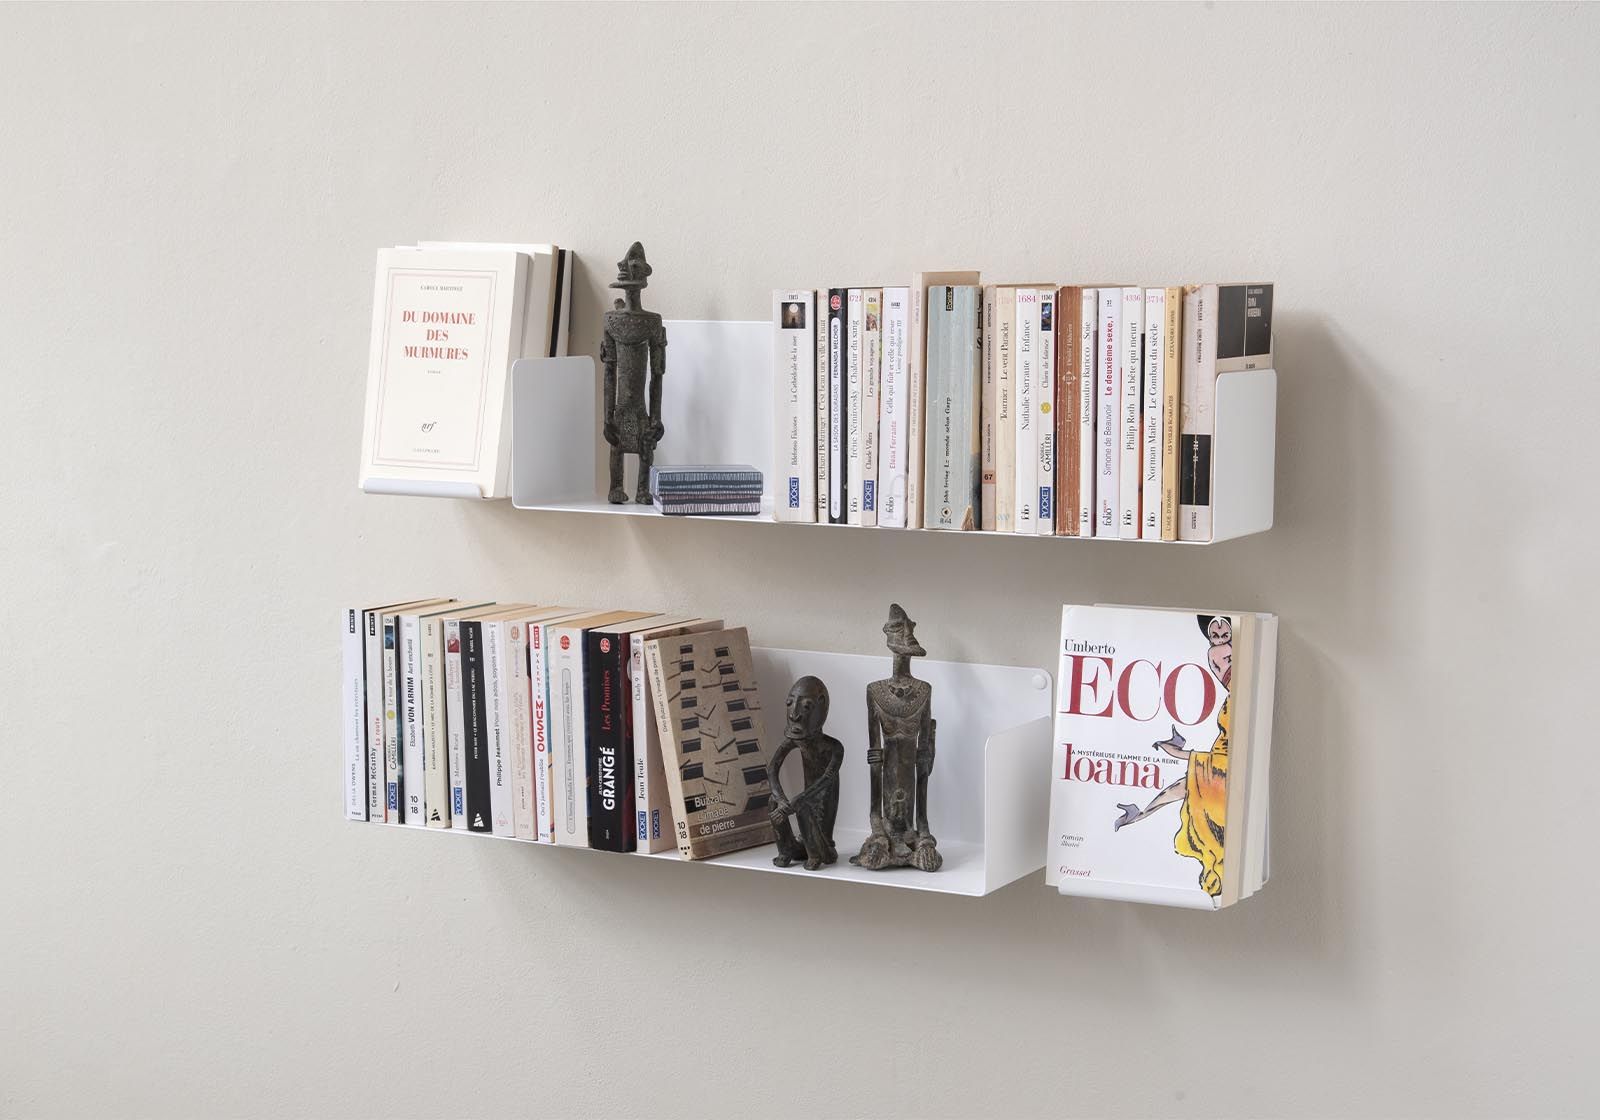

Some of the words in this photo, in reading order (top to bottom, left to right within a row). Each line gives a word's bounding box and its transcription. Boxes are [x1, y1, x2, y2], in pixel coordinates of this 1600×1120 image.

[1018, 294, 1037, 303] 1684
[402, 310, 420, 323] DU
[422, 311, 476, 325] DOMAINE
[426, 329, 449, 341] DES
[889, 335, 897, 347] qui
[1001, 322, 1009, 351] Paraclet
[1022, 320, 1030, 352] Enfance
[1106, 320, 1114, 343] sexe,
[1129, 321, 1137, 348] meurt
[1150, 323, 1158, 347] siècle
[403, 345, 469, 361] MURMURES
[850, 340, 858, 351] du
[1149, 349, 1157, 360] du
[1042, 361, 1049, 369] de
[1105, 344, 1113, 385] deuxième
[1129, 349, 1139, 364] qui
[850, 353, 858, 384] Chaleur
[1022, 360, 1030, 395] Sarraute
[1128, 366, 1136, 384] bête
[1149, 363, 1157, 396] Combat
[1105, 386, 1113, 396] Le
[1128, 385, 1136, 396] La
[886, 397, 894, 414] Celle
[1000, 388, 1008, 419] Tournier
[1082, 380, 1090, 426] Alessandro
[1149, 398, 1157, 409] Le
[1104, 404, 1112, 436] Beauvoir
[1127, 403, 1135, 424] Roth
[1126, 426, 1136, 451] Philip
[1148, 416, 1157, 443] Mailer
[1104, 438, 1112, 447] de
[1044, 433, 1052, 472] CAMILLERI
[1103, 449, 1112, 476] Simone
[1147, 447, 1156, 481] Norman
[790, 478, 799, 508] POCKET
[864, 480, 874, 511] POCKET
[1040, 487, 1050, 518] POCKET
[886, 497, 894, 513] folio
[1103, 508, 1112, 526] folio
[1064, 639, 1116, 655] Umberto
[601, 670, 610, 711] Promises
[1059, 653, 1217, 726] ECO
[407, 707, 415, 723] VON
[602, 714, 611, 730] Les
[535, 700, 545, 752] MUSSO
[1076, 750, 1115, 759] MYSTÉRIEUSE
[600, 746, 615, 810] GRANGÉ
[637, 781, 645, 800] Jean
[638, 811, 647, 840] POCKET
[677, 821, 686, 830] 10
[679, 831, 688, 839] 18
[700, 824, 710, 835] de
[711, 818, 735, 831] pierre
[1061, 833, 1084, 842] roman
[1059, 865, 1092, 878] Grasset
